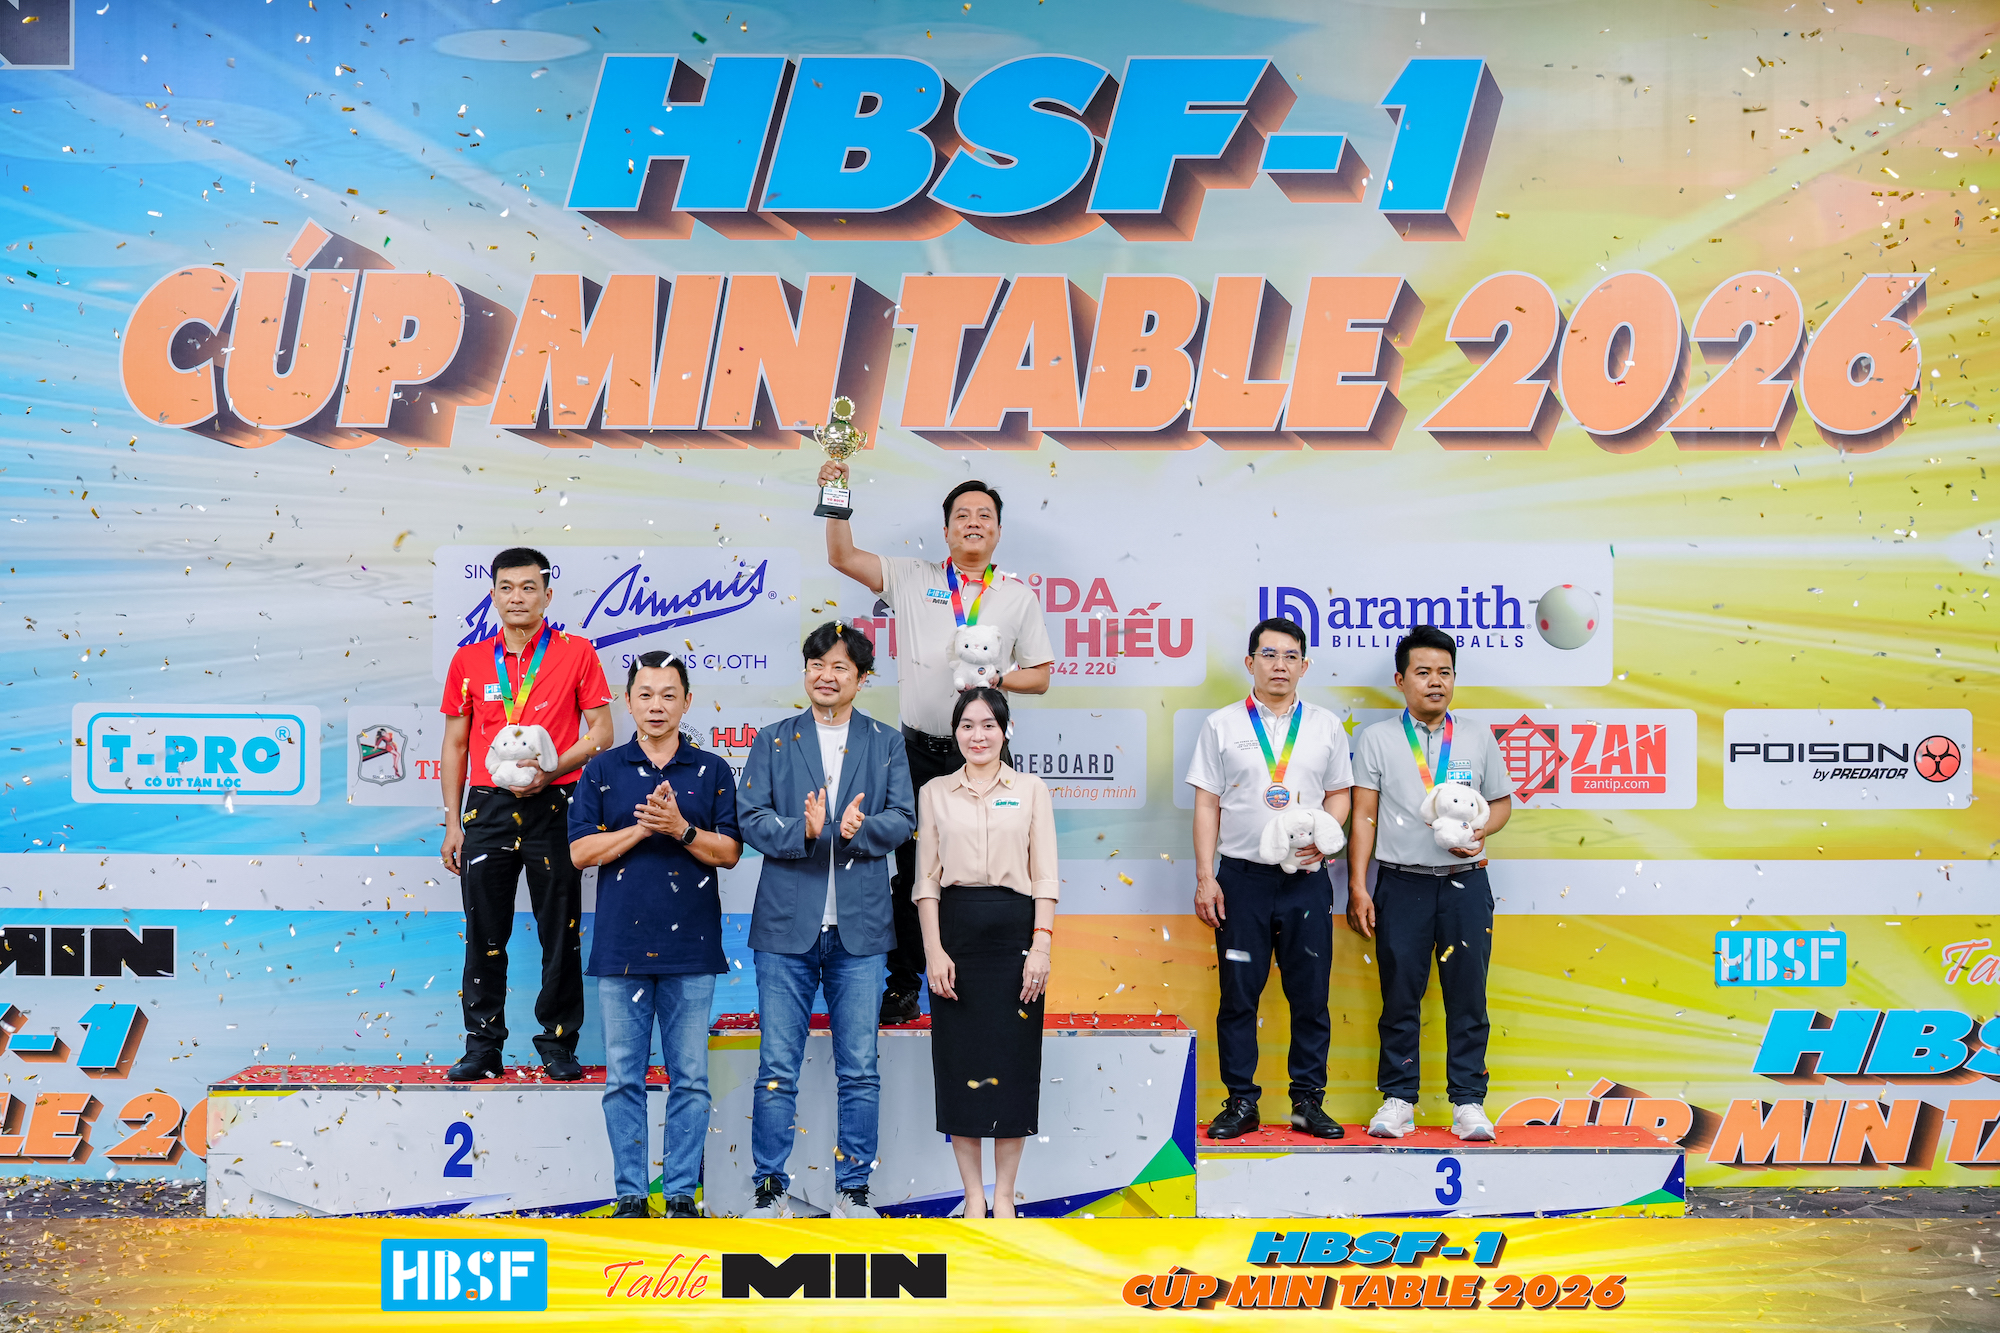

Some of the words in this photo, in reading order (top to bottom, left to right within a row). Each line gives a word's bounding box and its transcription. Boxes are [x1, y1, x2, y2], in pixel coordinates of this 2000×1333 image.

[564, 52, 1488, 217] HBSF-1
[120, 217, 466, 430] CÚP
[487, 271, 858, 431] MIN
[893, 271, 1406, 432] TABLE
[1414, 269, 1931, 436] 2026
[582, 559, 769, 630] Simonis
[1327, 584, 1526, 629] aramith
[1064, 602, 1194, 658] HIẾU
[1456, 635, 1524, 648] BALLS
[703, 654, 767, 669] CLOTH
[1085, 662, 1116, 675] 220
[102, 735, 281, 774] T-PRO
[1571, 724, 1667, 774] ZAN
[1729, 743, 1909, 763] POISON
[1060, 785, 1099, 801] thông
[1103, 785, 1137, 798] minh
[1583, 777, 1650, 791] zantip.com
[1813, 768, 1830, 781] by
[1830, 767, 1909, 780] PREDATOR
[1720, 937, 1842, 982] HBSF
[1941, 938, 2000, 985] Ta
[442, 1121, 473, 1178] 2
[1705, 1098, 1922, 1164] MIN
[1435, 1156, 1462, 1206] 3
